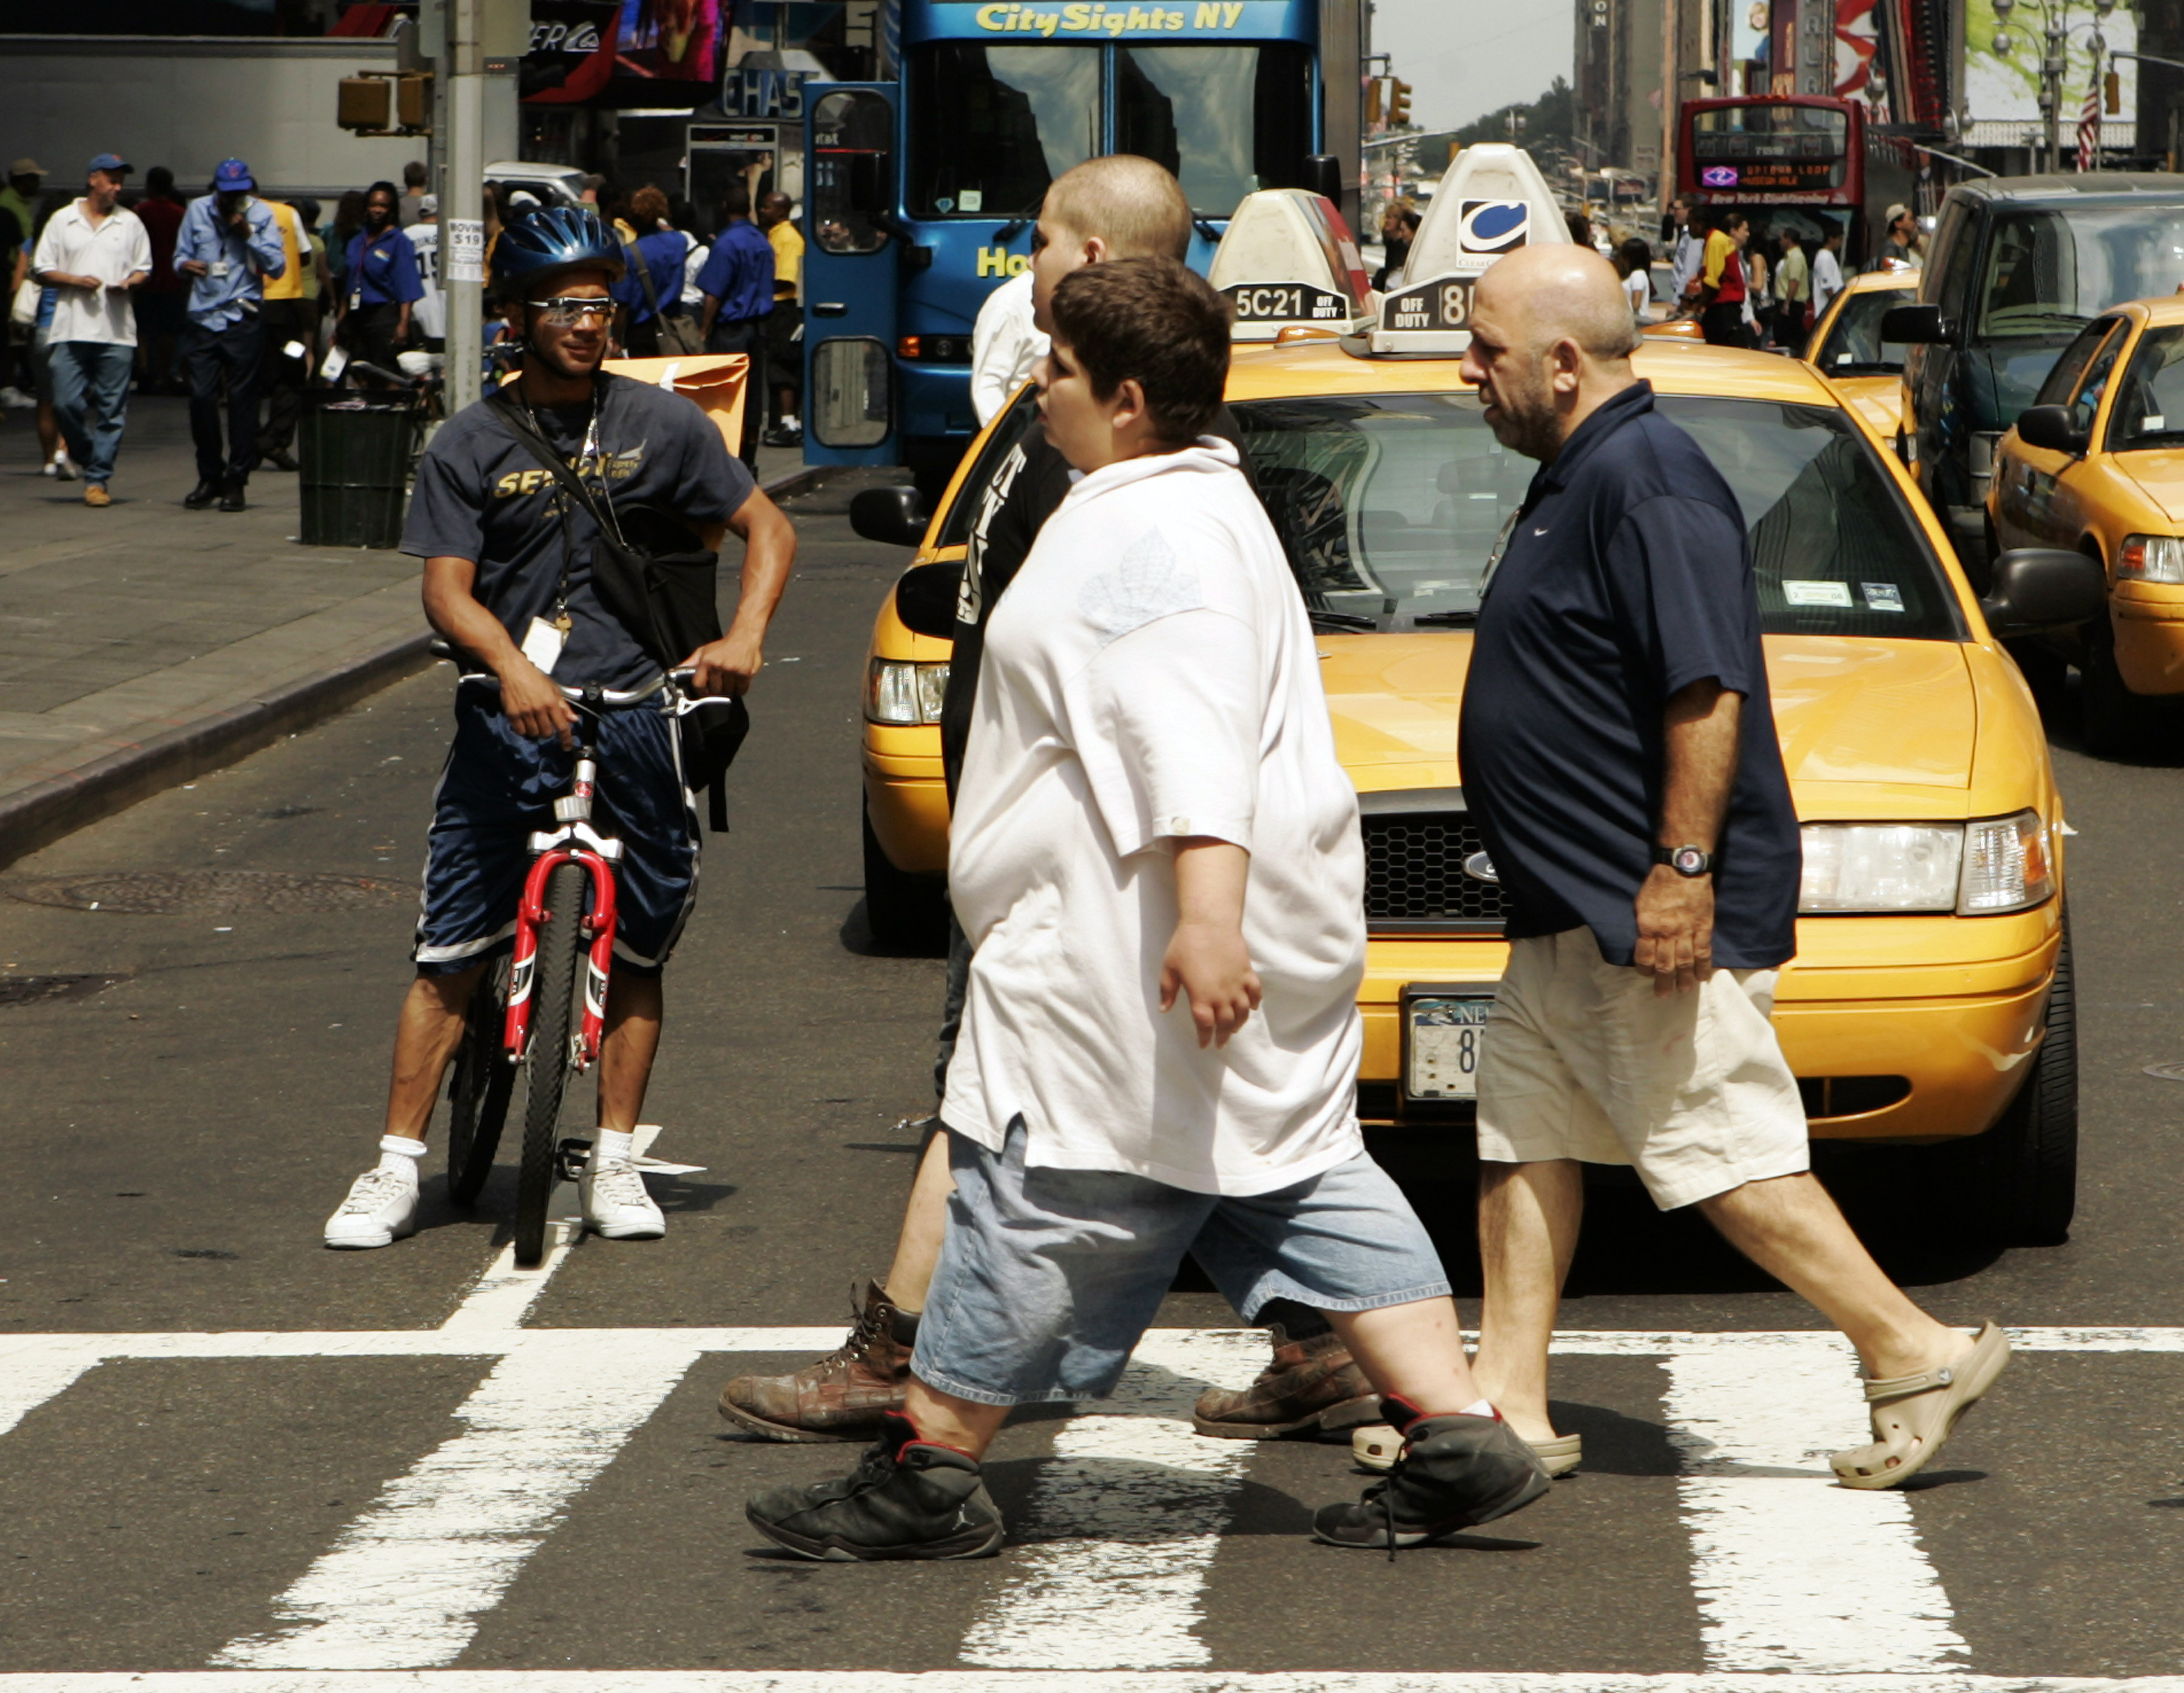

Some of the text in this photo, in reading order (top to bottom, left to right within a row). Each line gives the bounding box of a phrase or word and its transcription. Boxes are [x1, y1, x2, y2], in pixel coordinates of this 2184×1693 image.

[1193, 2, 1244, 29] NY
[723, 69, 820, 117] CHAS
[1236, 289, 1302, 317] 5C21
[1316, 295, 1334, 307] OFF
[1400, 298, 1424, 312] OFF
[1312, 307, 1338, 318] DUTY
[1395, 313, 1430, 328] DUTY
[1460, 1006, 1490, 1024] NE
